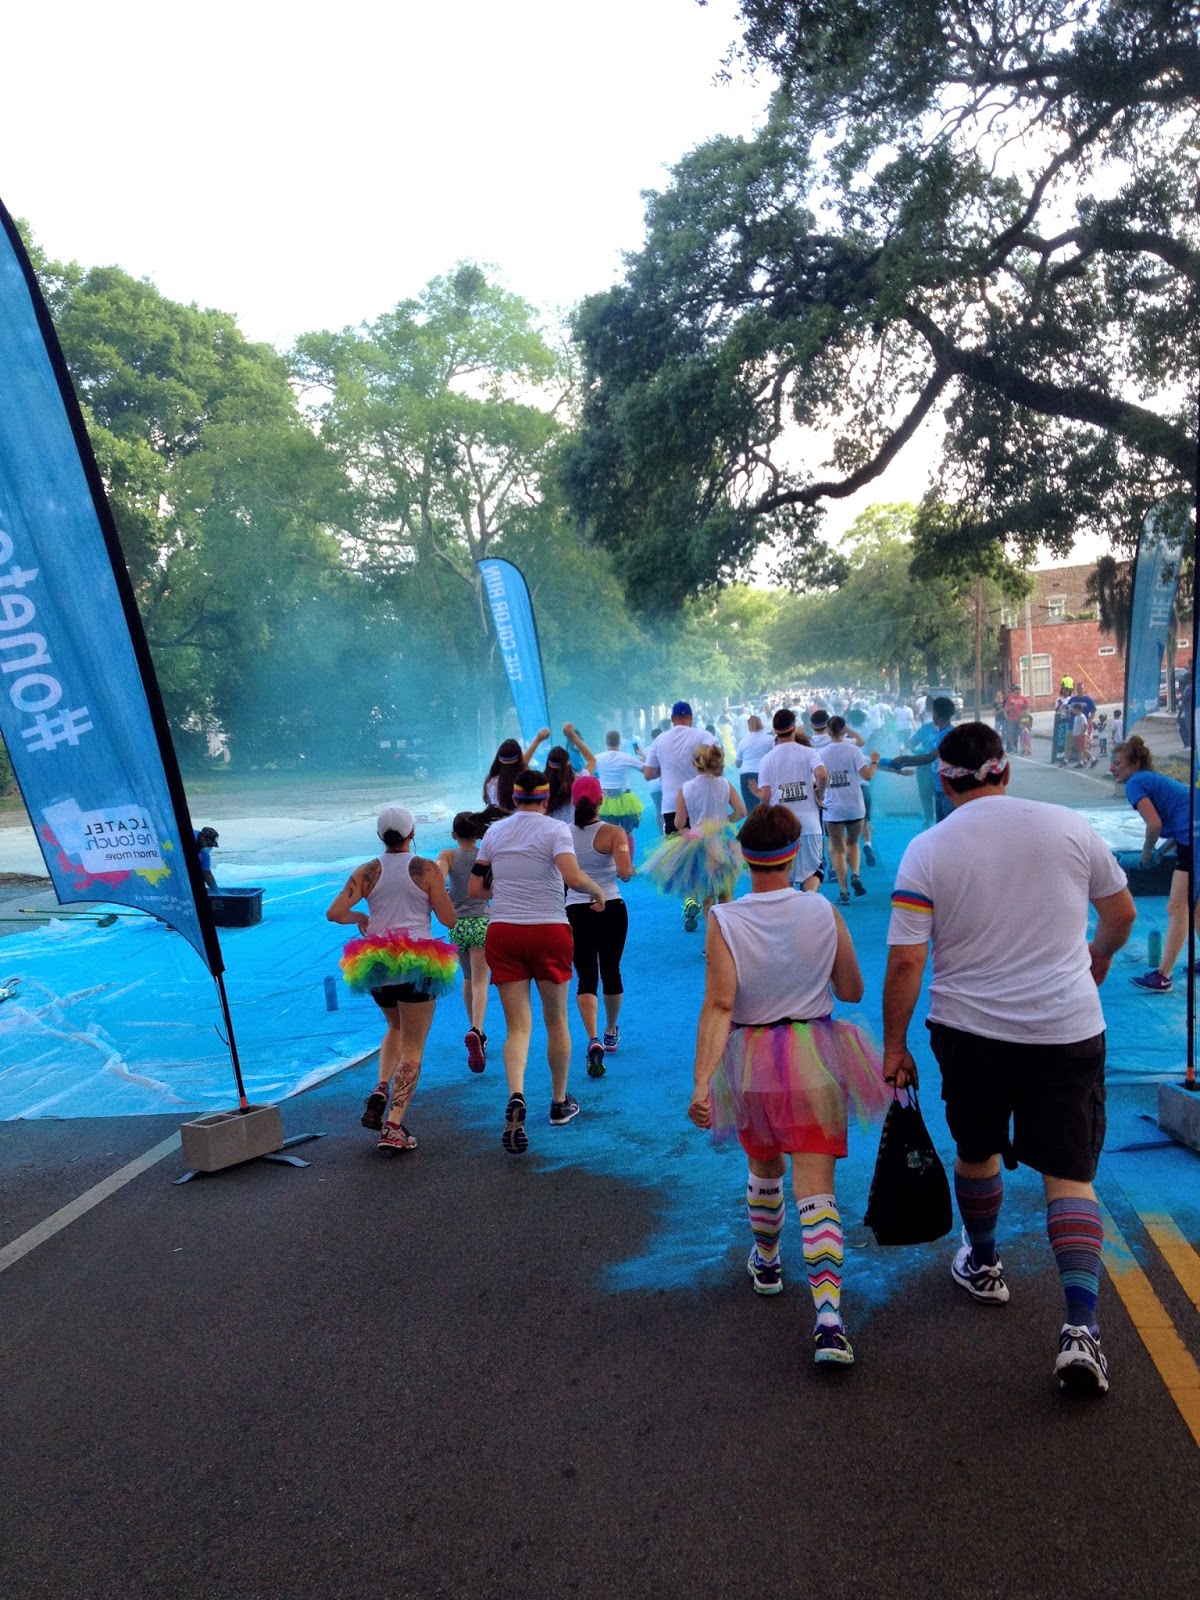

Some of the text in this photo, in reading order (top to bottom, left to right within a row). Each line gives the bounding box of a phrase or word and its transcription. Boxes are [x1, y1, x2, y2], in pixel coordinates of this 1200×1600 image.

[1149, 597, 1171, 628] THE
[781, 786, 804, 798] 79101
[758, 1186, 780, 1196] RUN
